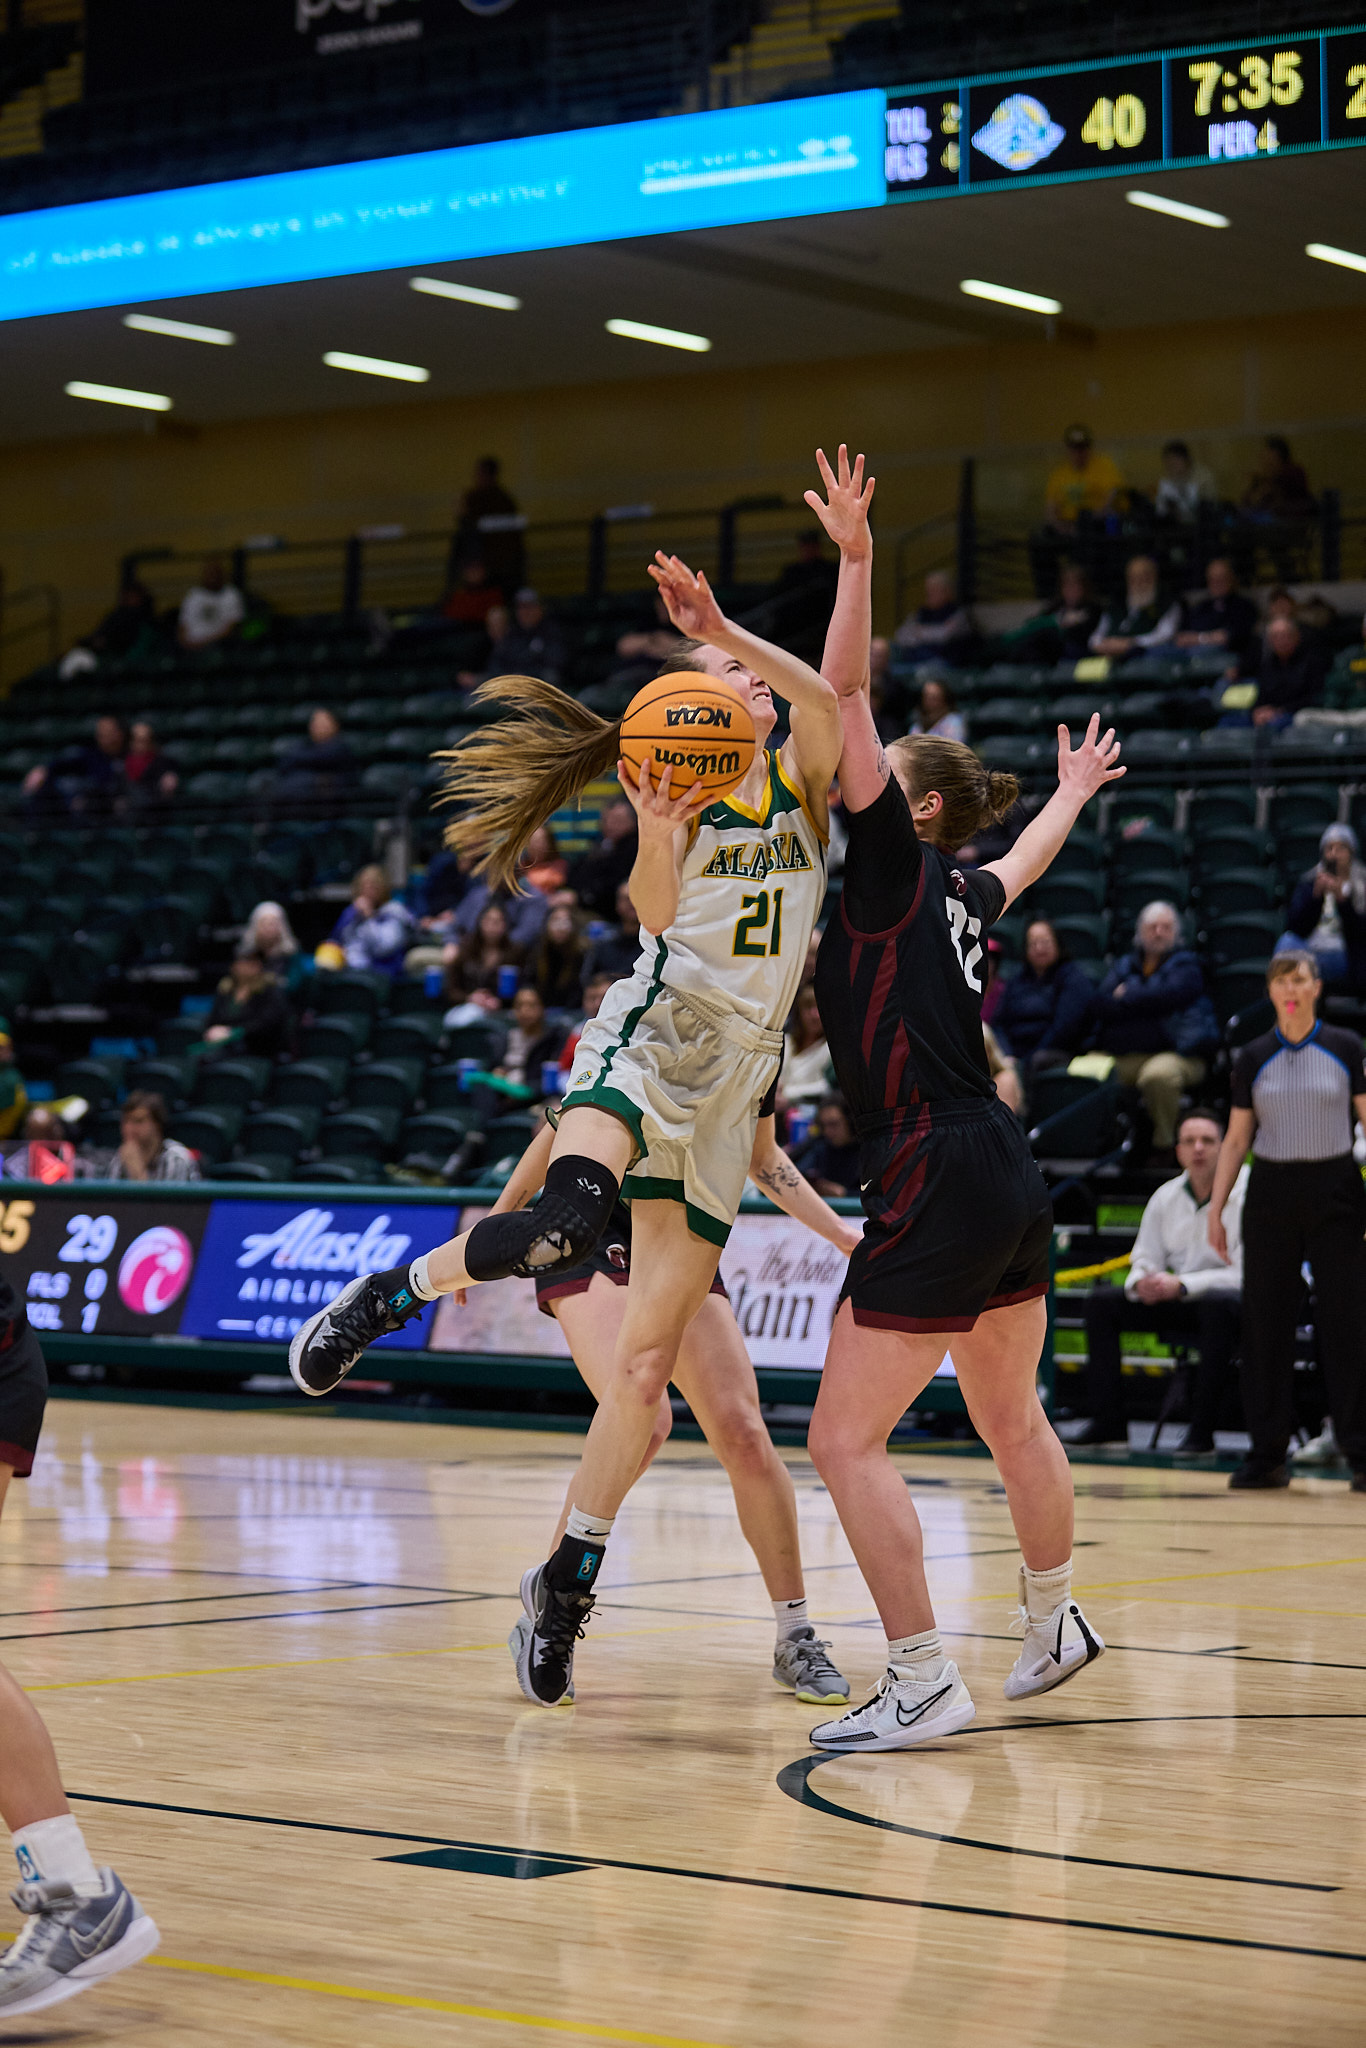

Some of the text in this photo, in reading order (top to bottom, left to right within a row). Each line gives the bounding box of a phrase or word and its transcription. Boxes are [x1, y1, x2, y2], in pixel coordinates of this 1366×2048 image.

[1188, 51, 1304, 117] 7:35
[1082, 93, 1147, 151] 40
[1208, 120, 1258, 160] PER
[664, 704, 732, 729] NCAA
[654, 746, 740, 776] Wilson
[731, 887, 785, 958] 21
[0, 1199, 36, 1254] 5
[57, 1214, 118, 1263] 29
[235, 1207, 413, 1277] Alaska
[84, 1268, 108, 1301] 0
[81, 1301, 101, 1333] 1
